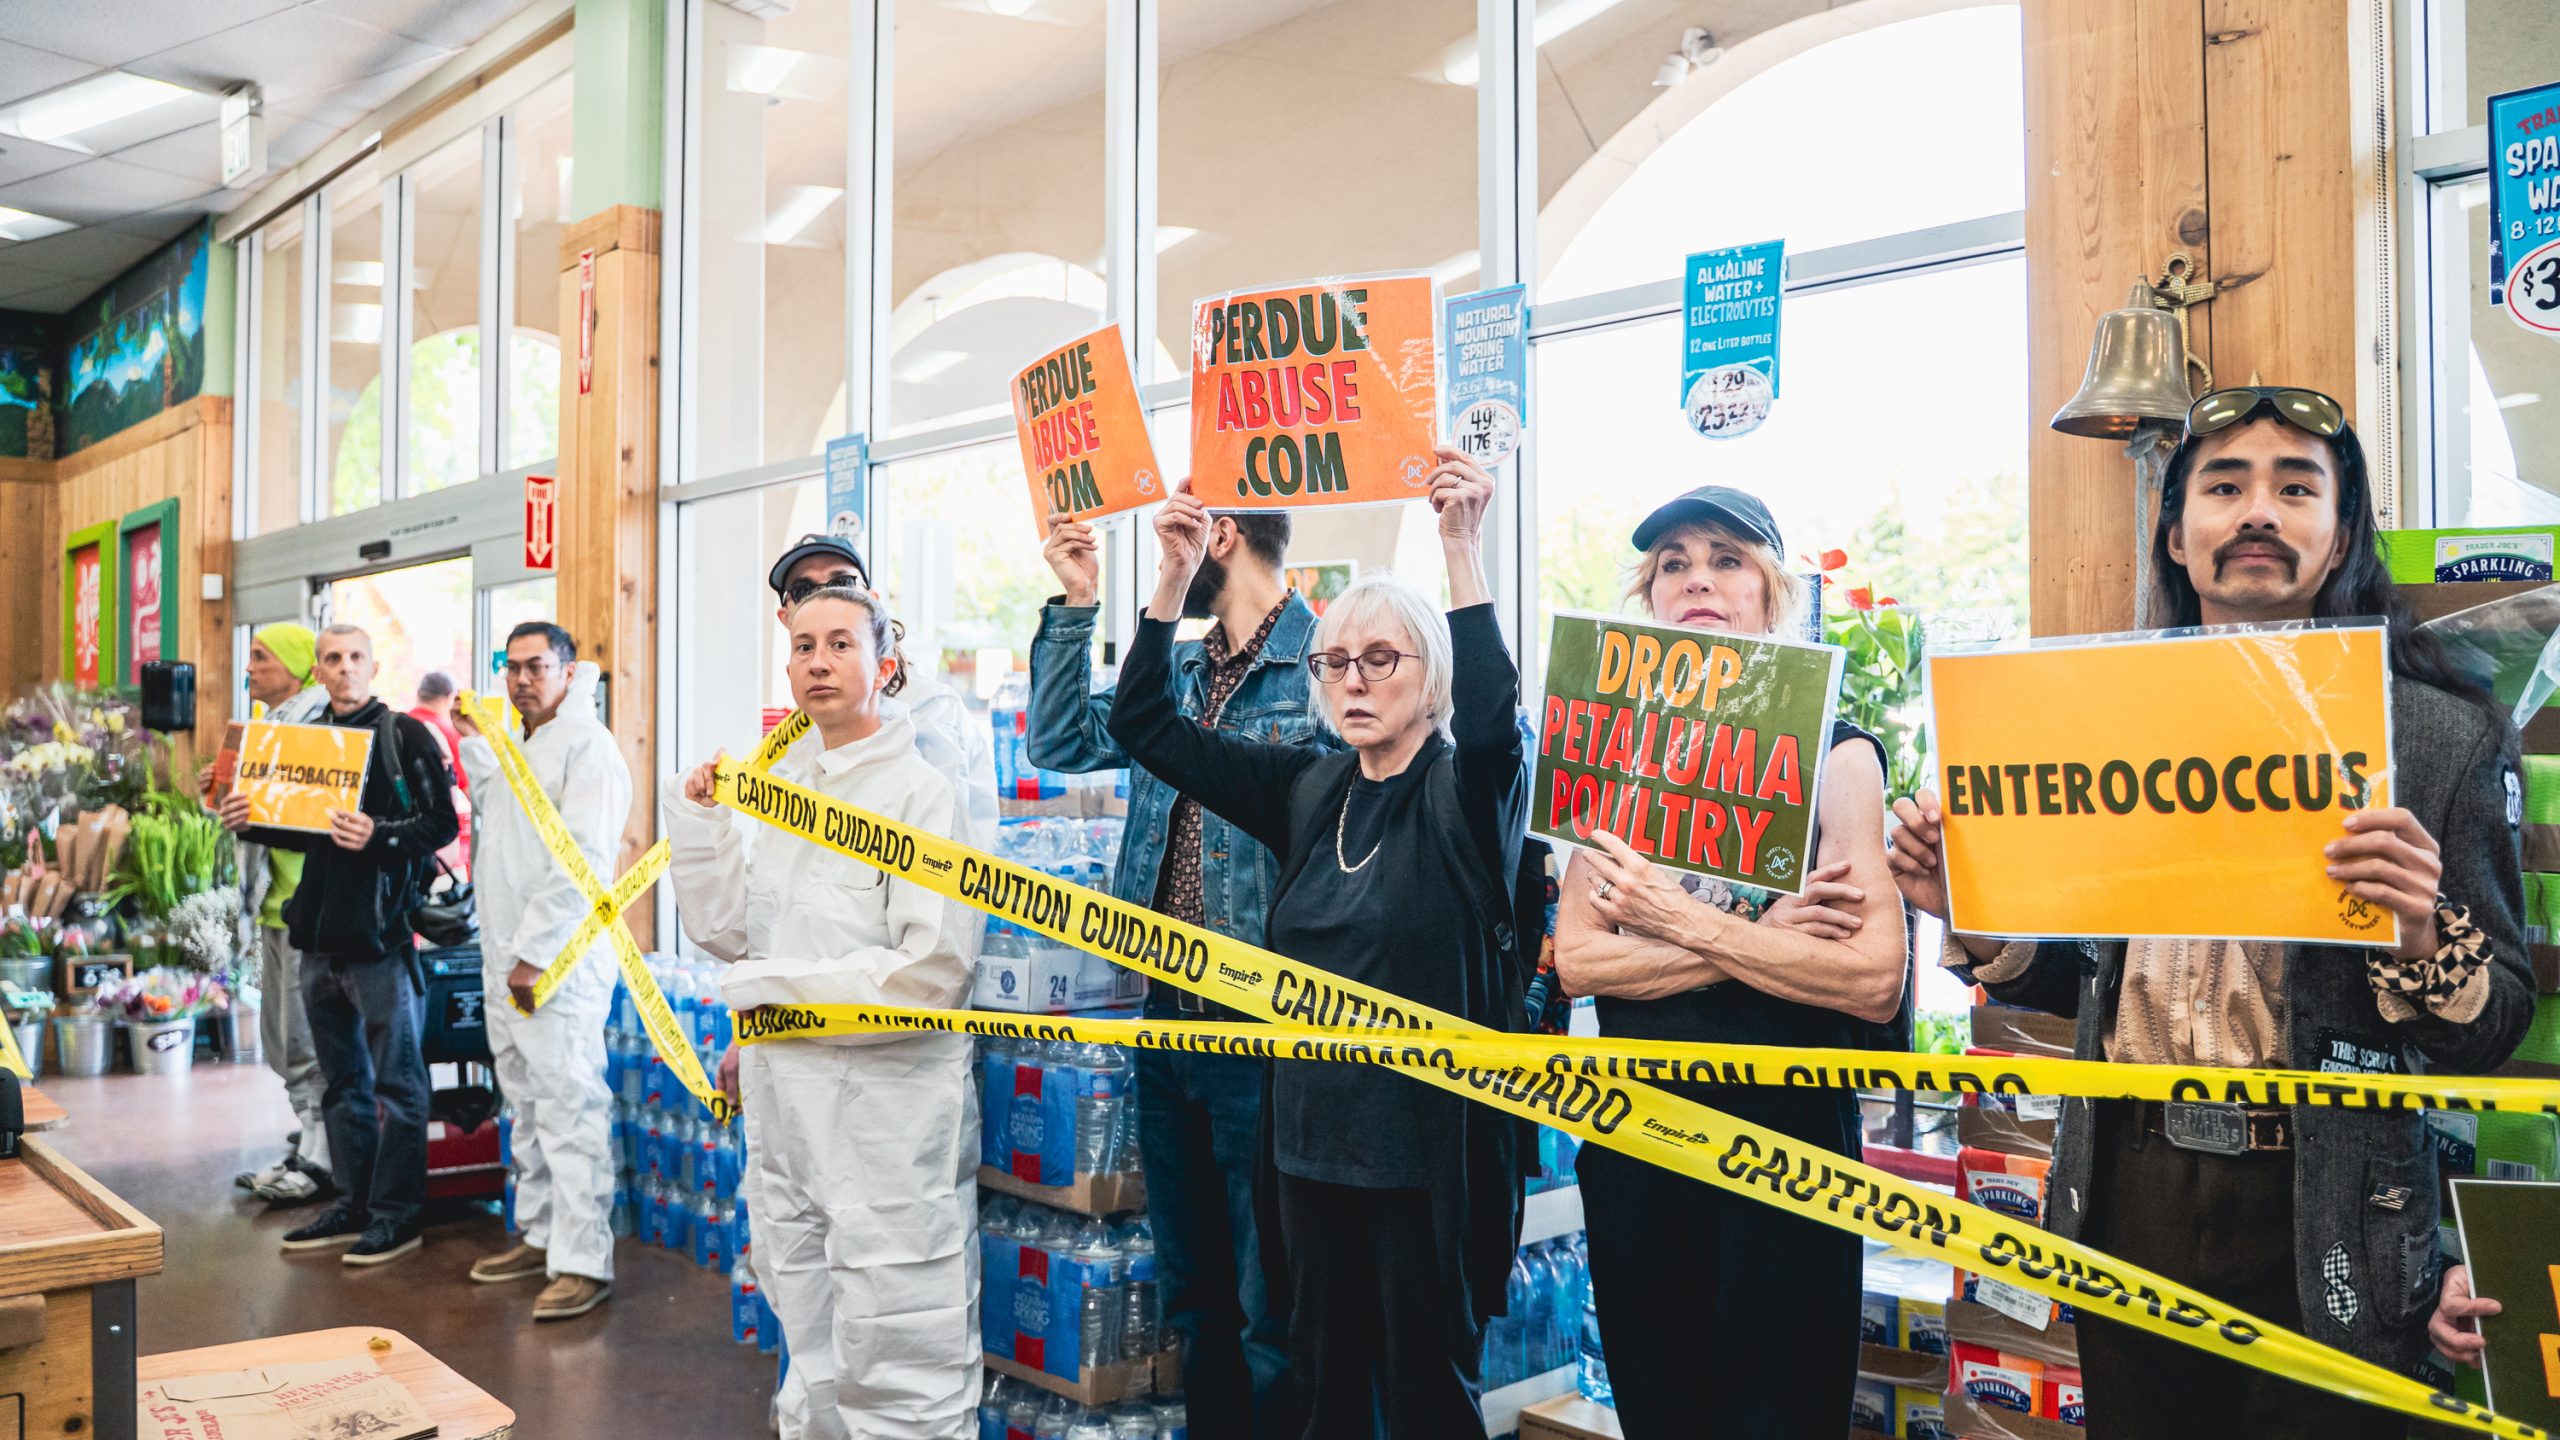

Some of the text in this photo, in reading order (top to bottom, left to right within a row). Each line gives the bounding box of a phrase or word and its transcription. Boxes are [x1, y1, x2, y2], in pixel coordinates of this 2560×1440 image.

[1697, 258, 1766, 285] ALKALINE
[1455, 304, 1514, 329] NATURAL
[1690, 296, 1776, 327] ELECTROLYTES
[1209, 288, 1369, 367] PERDUE
[1454, 319, 1516, 346] MOUNTAIN
[1461, 340, 1505, 363] SPRING
[1689, 333, 1772, 354] 12 ONE LITER BOTTLES
[1458, 356, 1505, 377] WATER
[1019, 342, 1096, 424] PERDUE
[1216, 360, 1361, 432] ABUSE
[1031, 401, 1100, 474] ABUSE
[1236, 431, 1349, 499] .COM
[2465, 541, 2518, 551] TRADER JOE'S
[2452, 557, 2535, 579] SPARKLING
[1596, 630, 1743, 712] DROP
[767, 708, 811, 760] CAUTIO
[1541, 695, 1804, 806] PETALUMA
[1946, 751, 2372, 816] ENTEROCOCCUS
[1550, 768, 1776, 876] POULTRY
[1050, 975, 1067, 998] 24
[737, 772, 818, 833] CAUTION
[824, 806, 915, 872] CUIDADO
[922, 853, 949, 871] Empire
[959, 857, 1071, 933] CAUTION
[1080, 902, 1209, 983] CUIDADO
[1219, 962, 1256, 985] Empire
[1643, 1118, 1698, 1144] Empire
[1718, 1134, 1962, 1248] CAUTION
[2331, 1040, 2357, 1063] THIS
[1979, 1190, 2028, 1208] SPARKLING
[1974, 1382, 2021, 1402] SPARKLING
